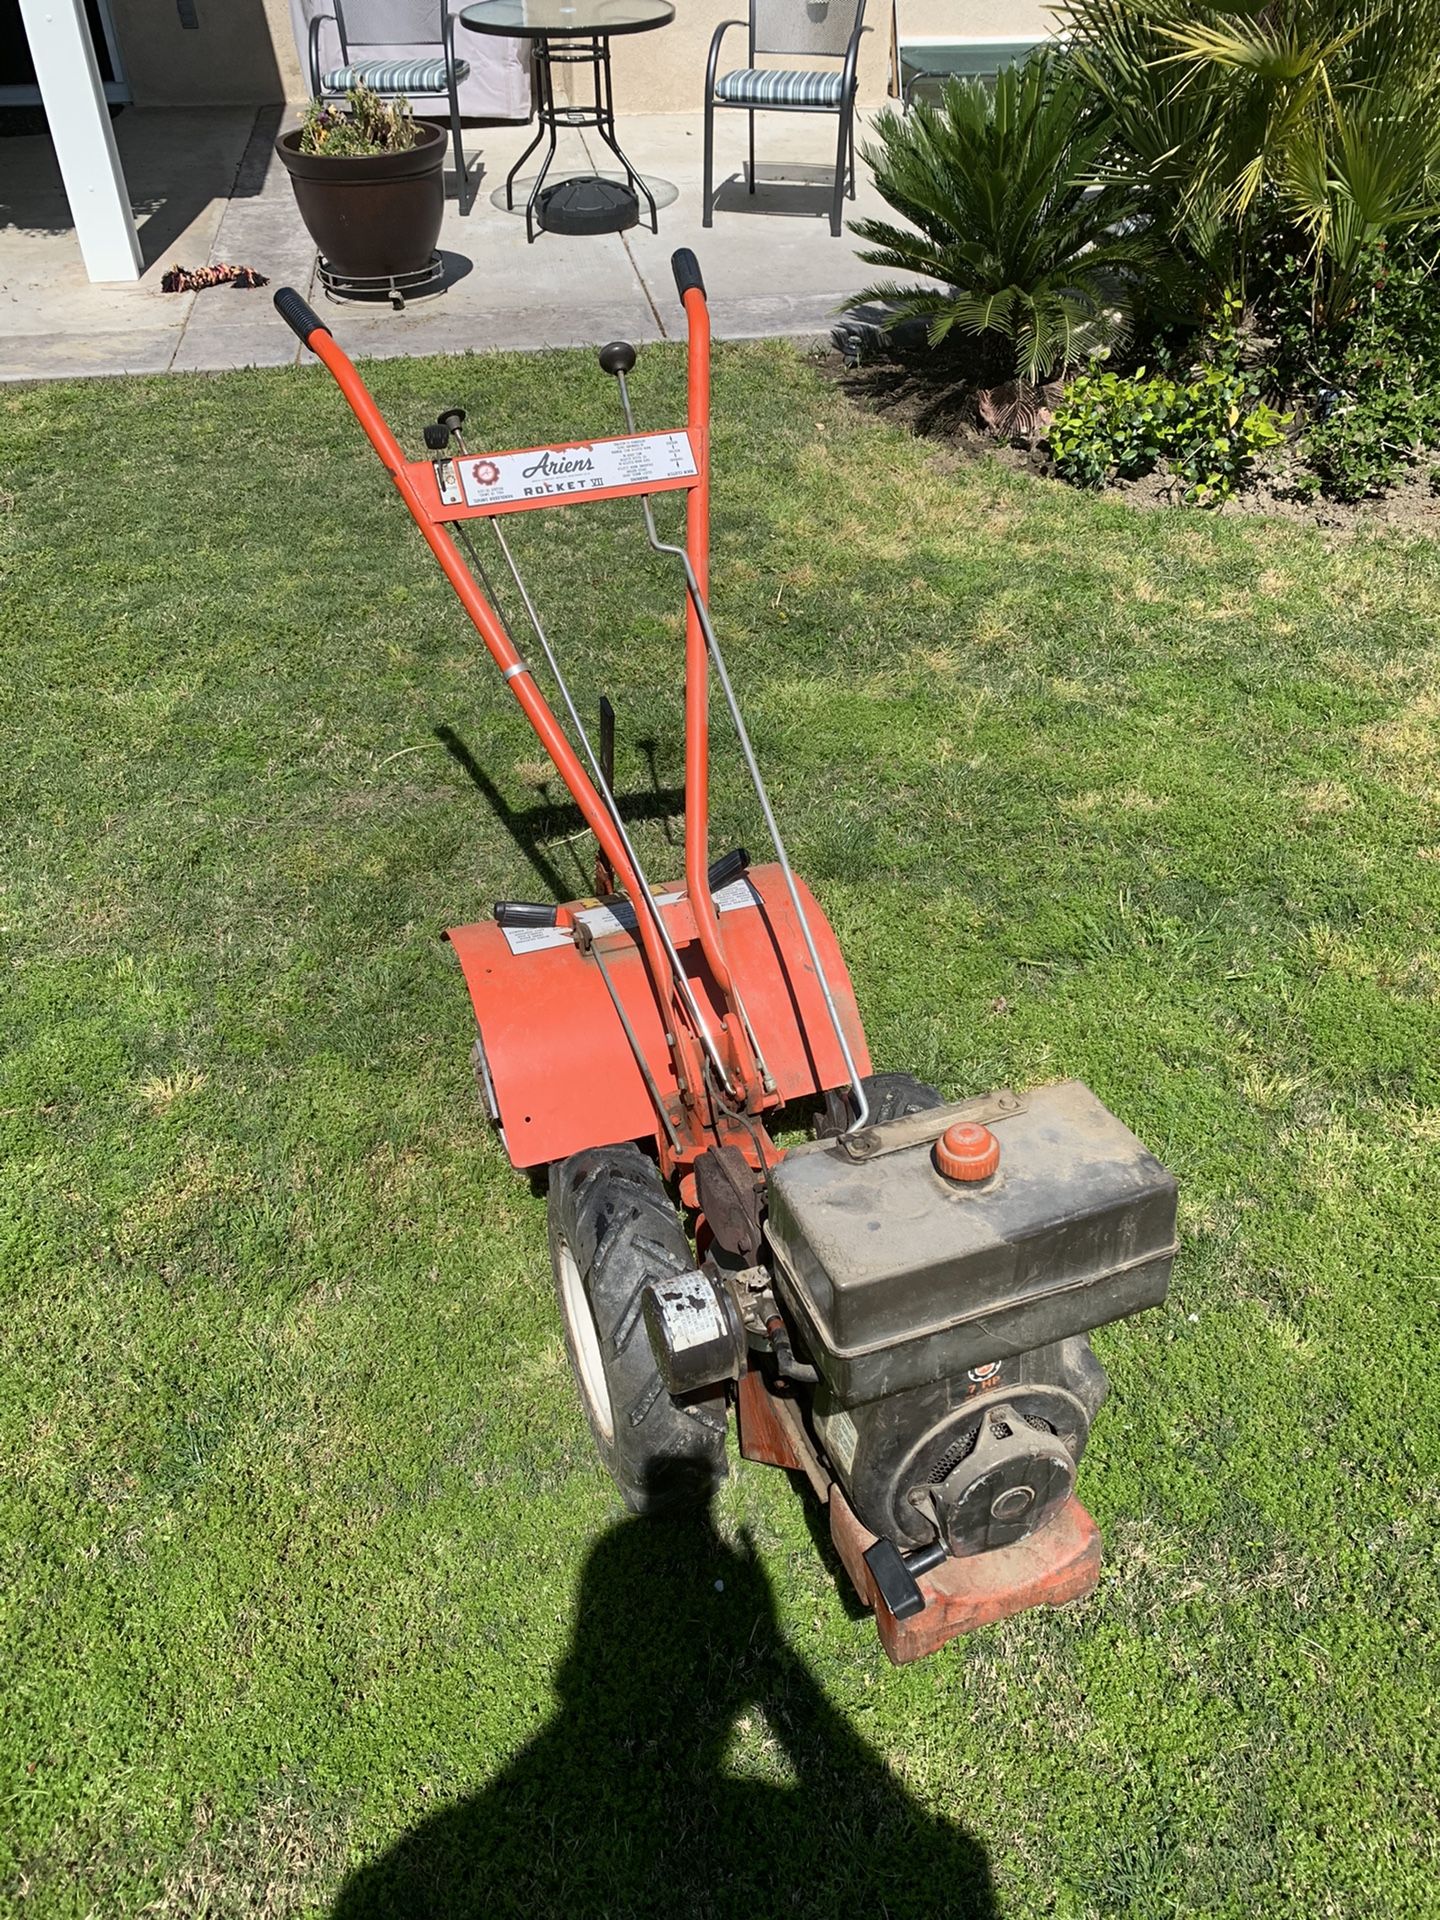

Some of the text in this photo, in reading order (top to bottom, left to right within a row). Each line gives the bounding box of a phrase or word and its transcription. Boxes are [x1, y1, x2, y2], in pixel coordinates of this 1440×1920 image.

[522, 451, 595, 479] Ariens
[523, 480, 586, 497] ROCKET
[590, 477, 604, 488] VII
[968, 1375, 1001, 1394] 7 HP
